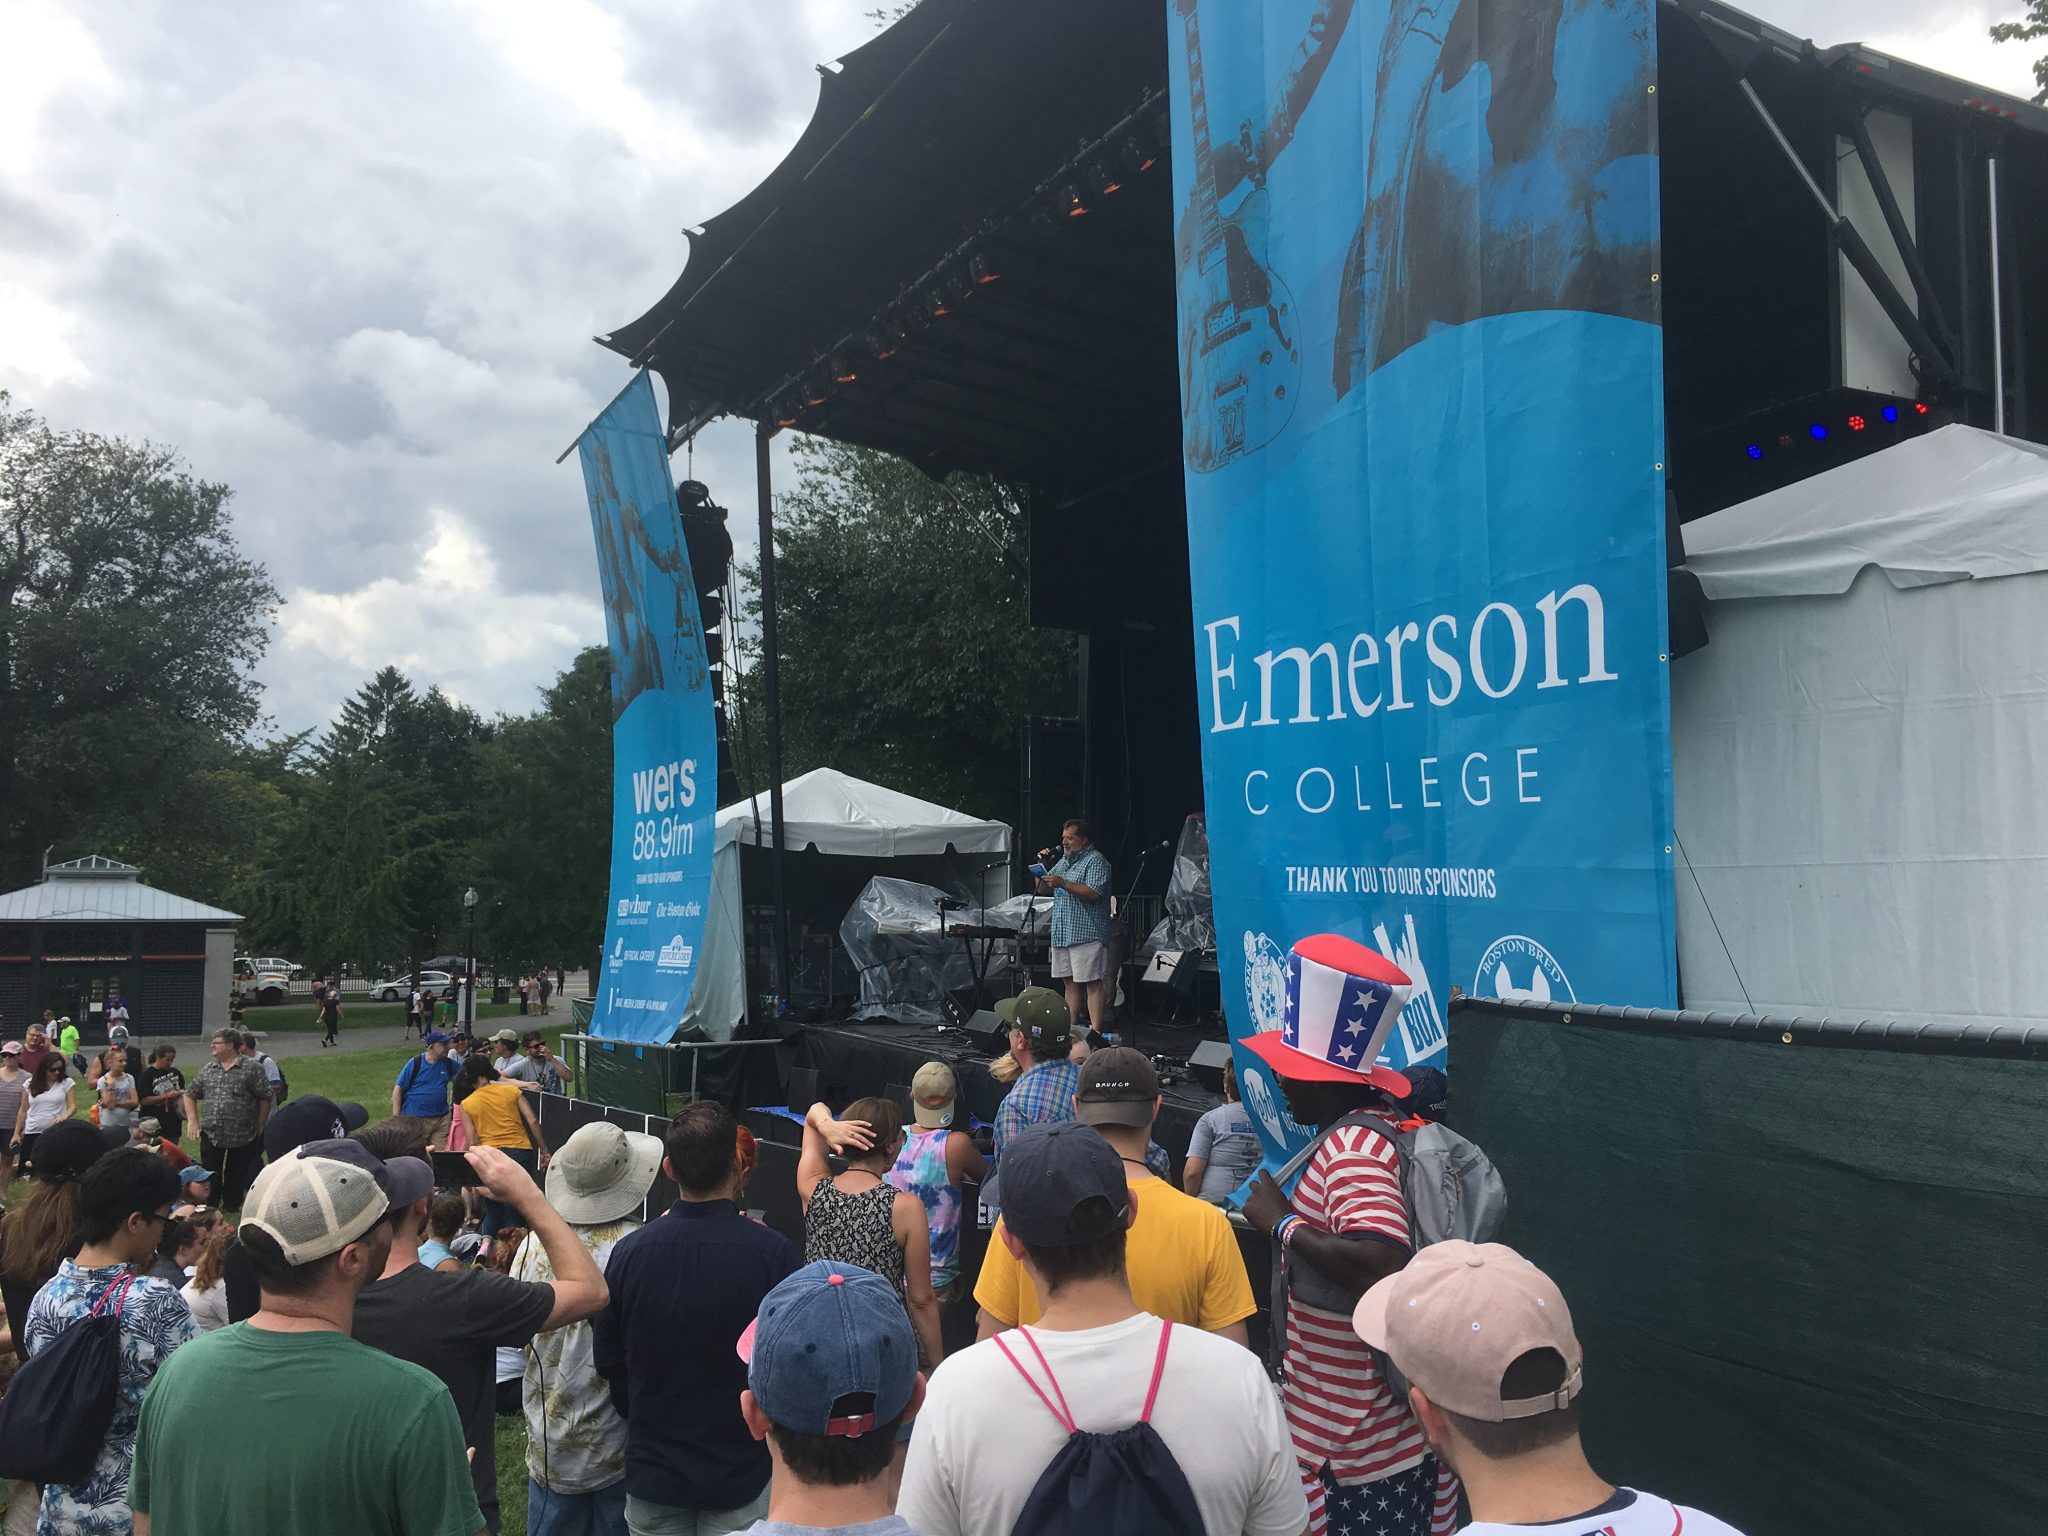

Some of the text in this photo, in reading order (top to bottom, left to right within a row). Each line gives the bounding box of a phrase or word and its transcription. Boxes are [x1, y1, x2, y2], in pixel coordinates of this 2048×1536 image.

[1203, 583, 1619, 733] Emerson
[633, 759, 696, 815] wers
[1244, 748, 1541, 815] COLLEGE
[633, 814, 693, 860] 88.9fm
[1286, 866, 1496, 898] THANK YOU TO OUR SPONSORS
[1482, 940, 1561, 983] BOSTON BRED
[1401, 990, 1442, 1053] BOX
